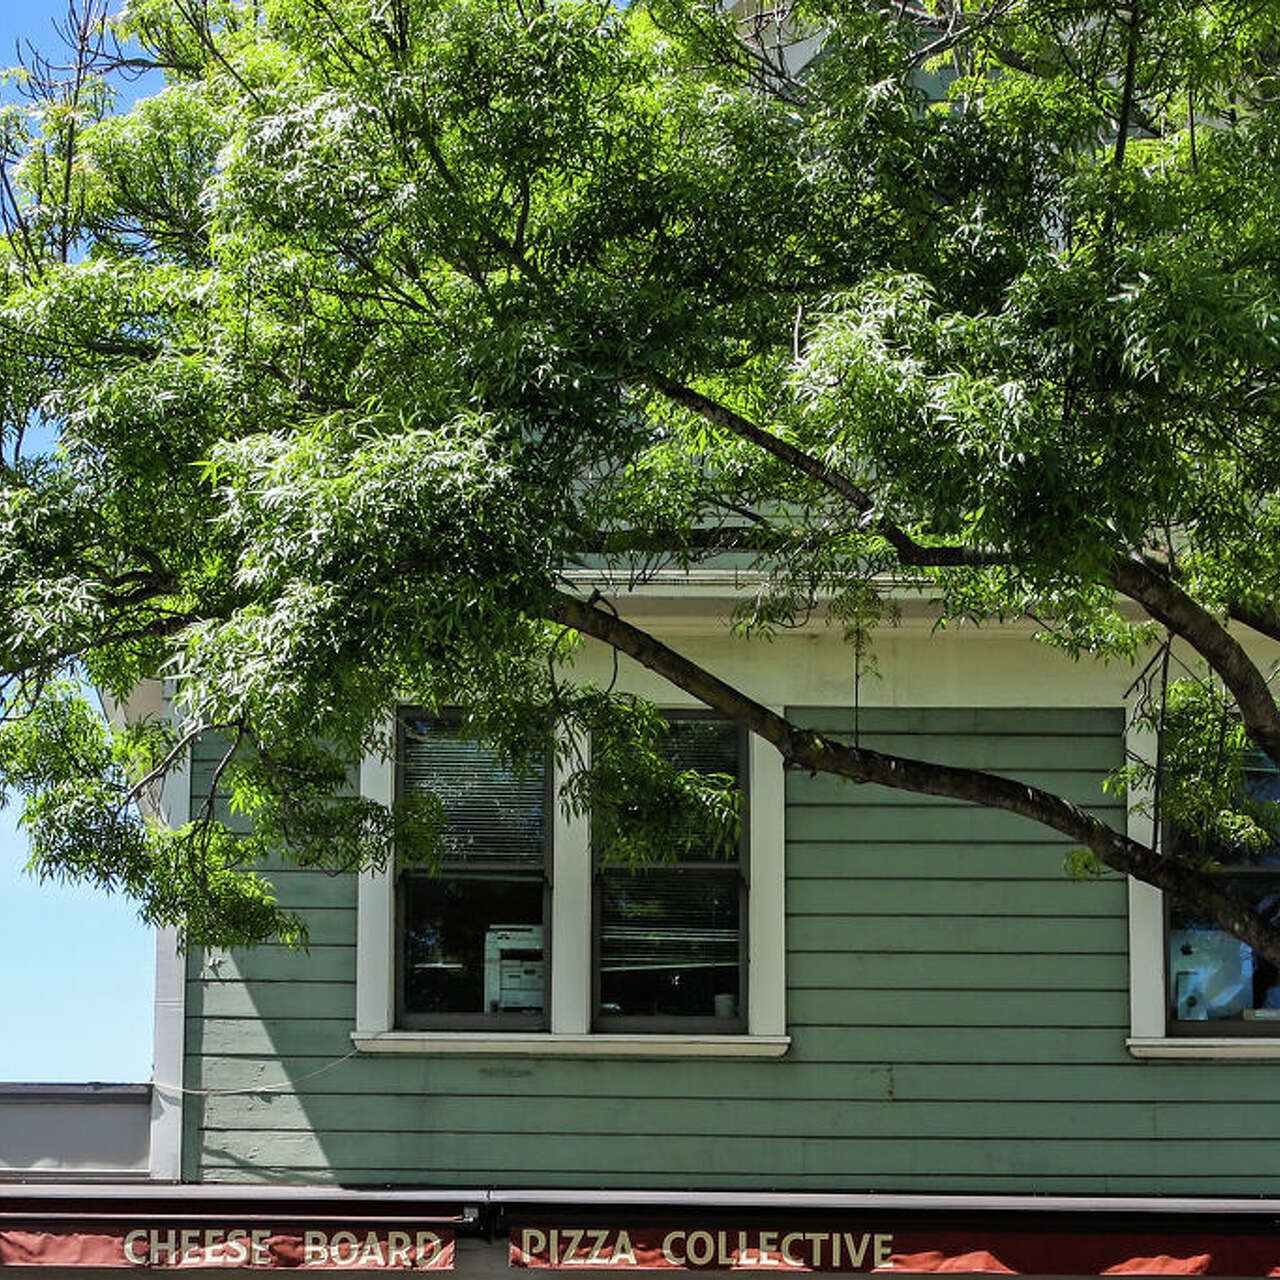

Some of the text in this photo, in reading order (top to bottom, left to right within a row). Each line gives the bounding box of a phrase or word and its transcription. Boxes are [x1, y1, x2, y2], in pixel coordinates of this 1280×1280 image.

[123, 1228, 442, 1267] CHEESE BOARD
[521, 1228, 895, 1268] PIZZA COLLECTIVE
